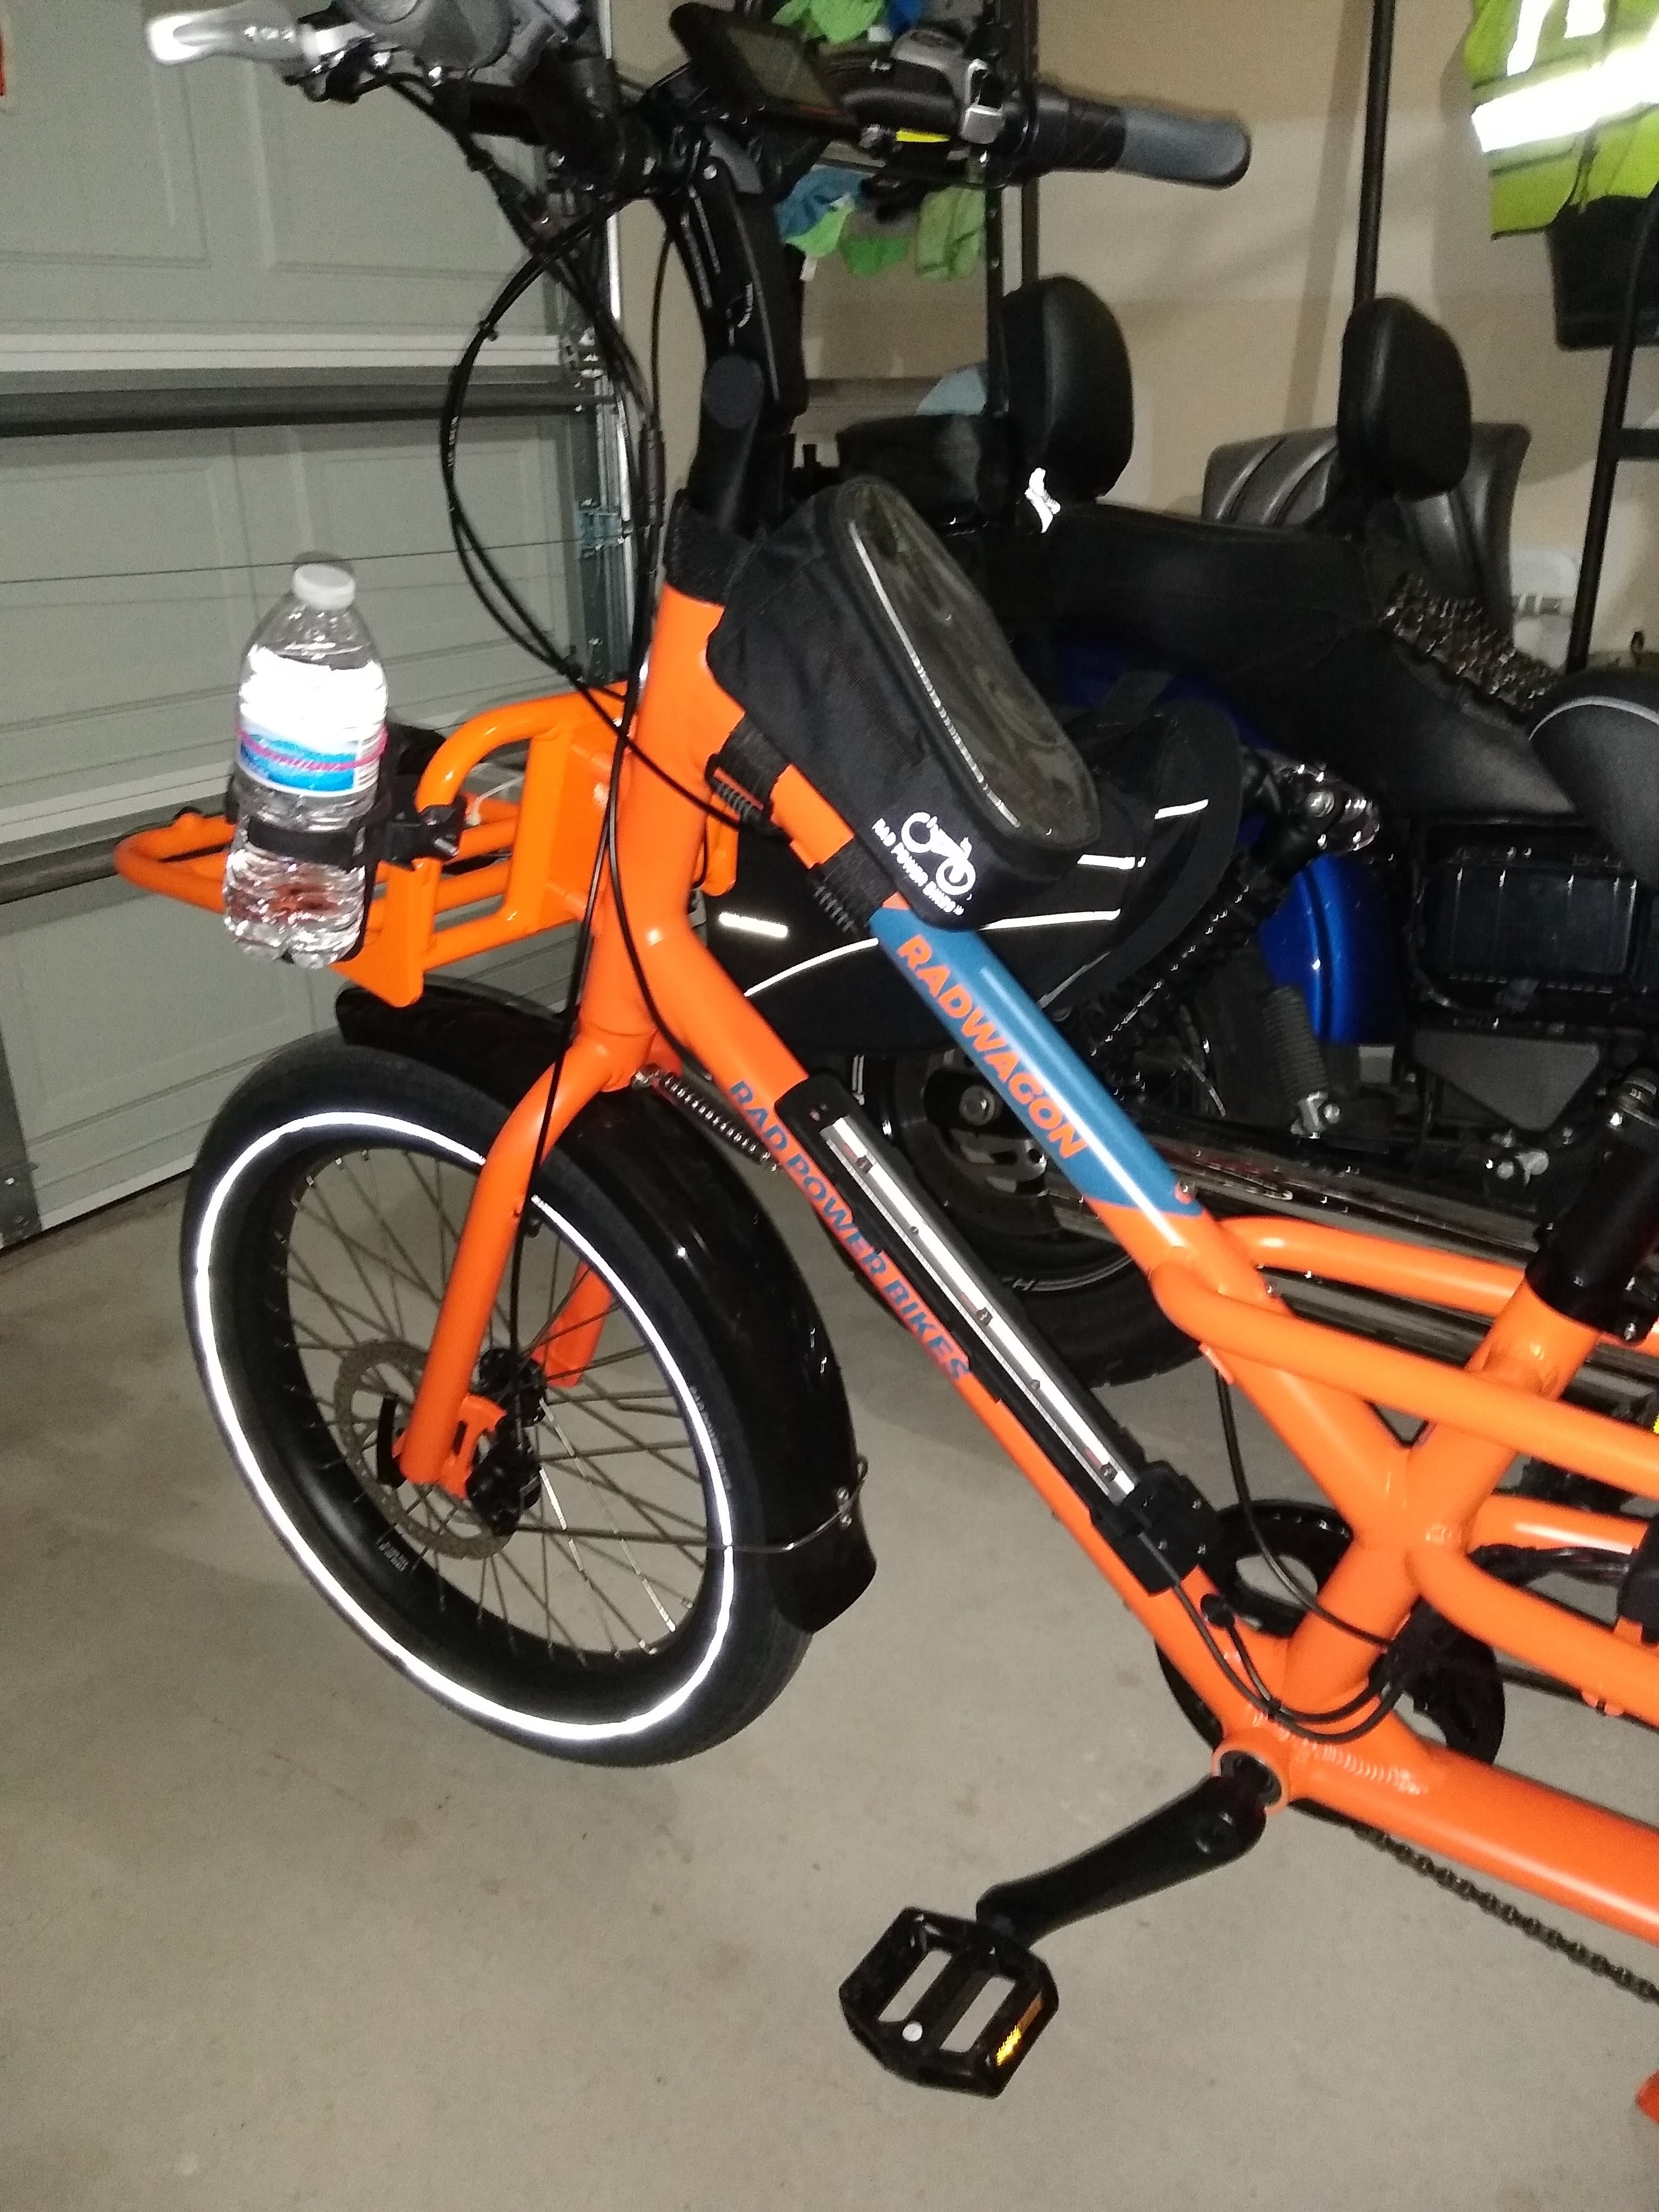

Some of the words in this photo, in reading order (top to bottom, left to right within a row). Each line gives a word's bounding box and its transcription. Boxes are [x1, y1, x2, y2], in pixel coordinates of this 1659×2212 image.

[730, 1081, 788, 1151] RAD
[787, 1155, 886, 1274] POWER
[885, 1280, 971, 1378] BIKES
